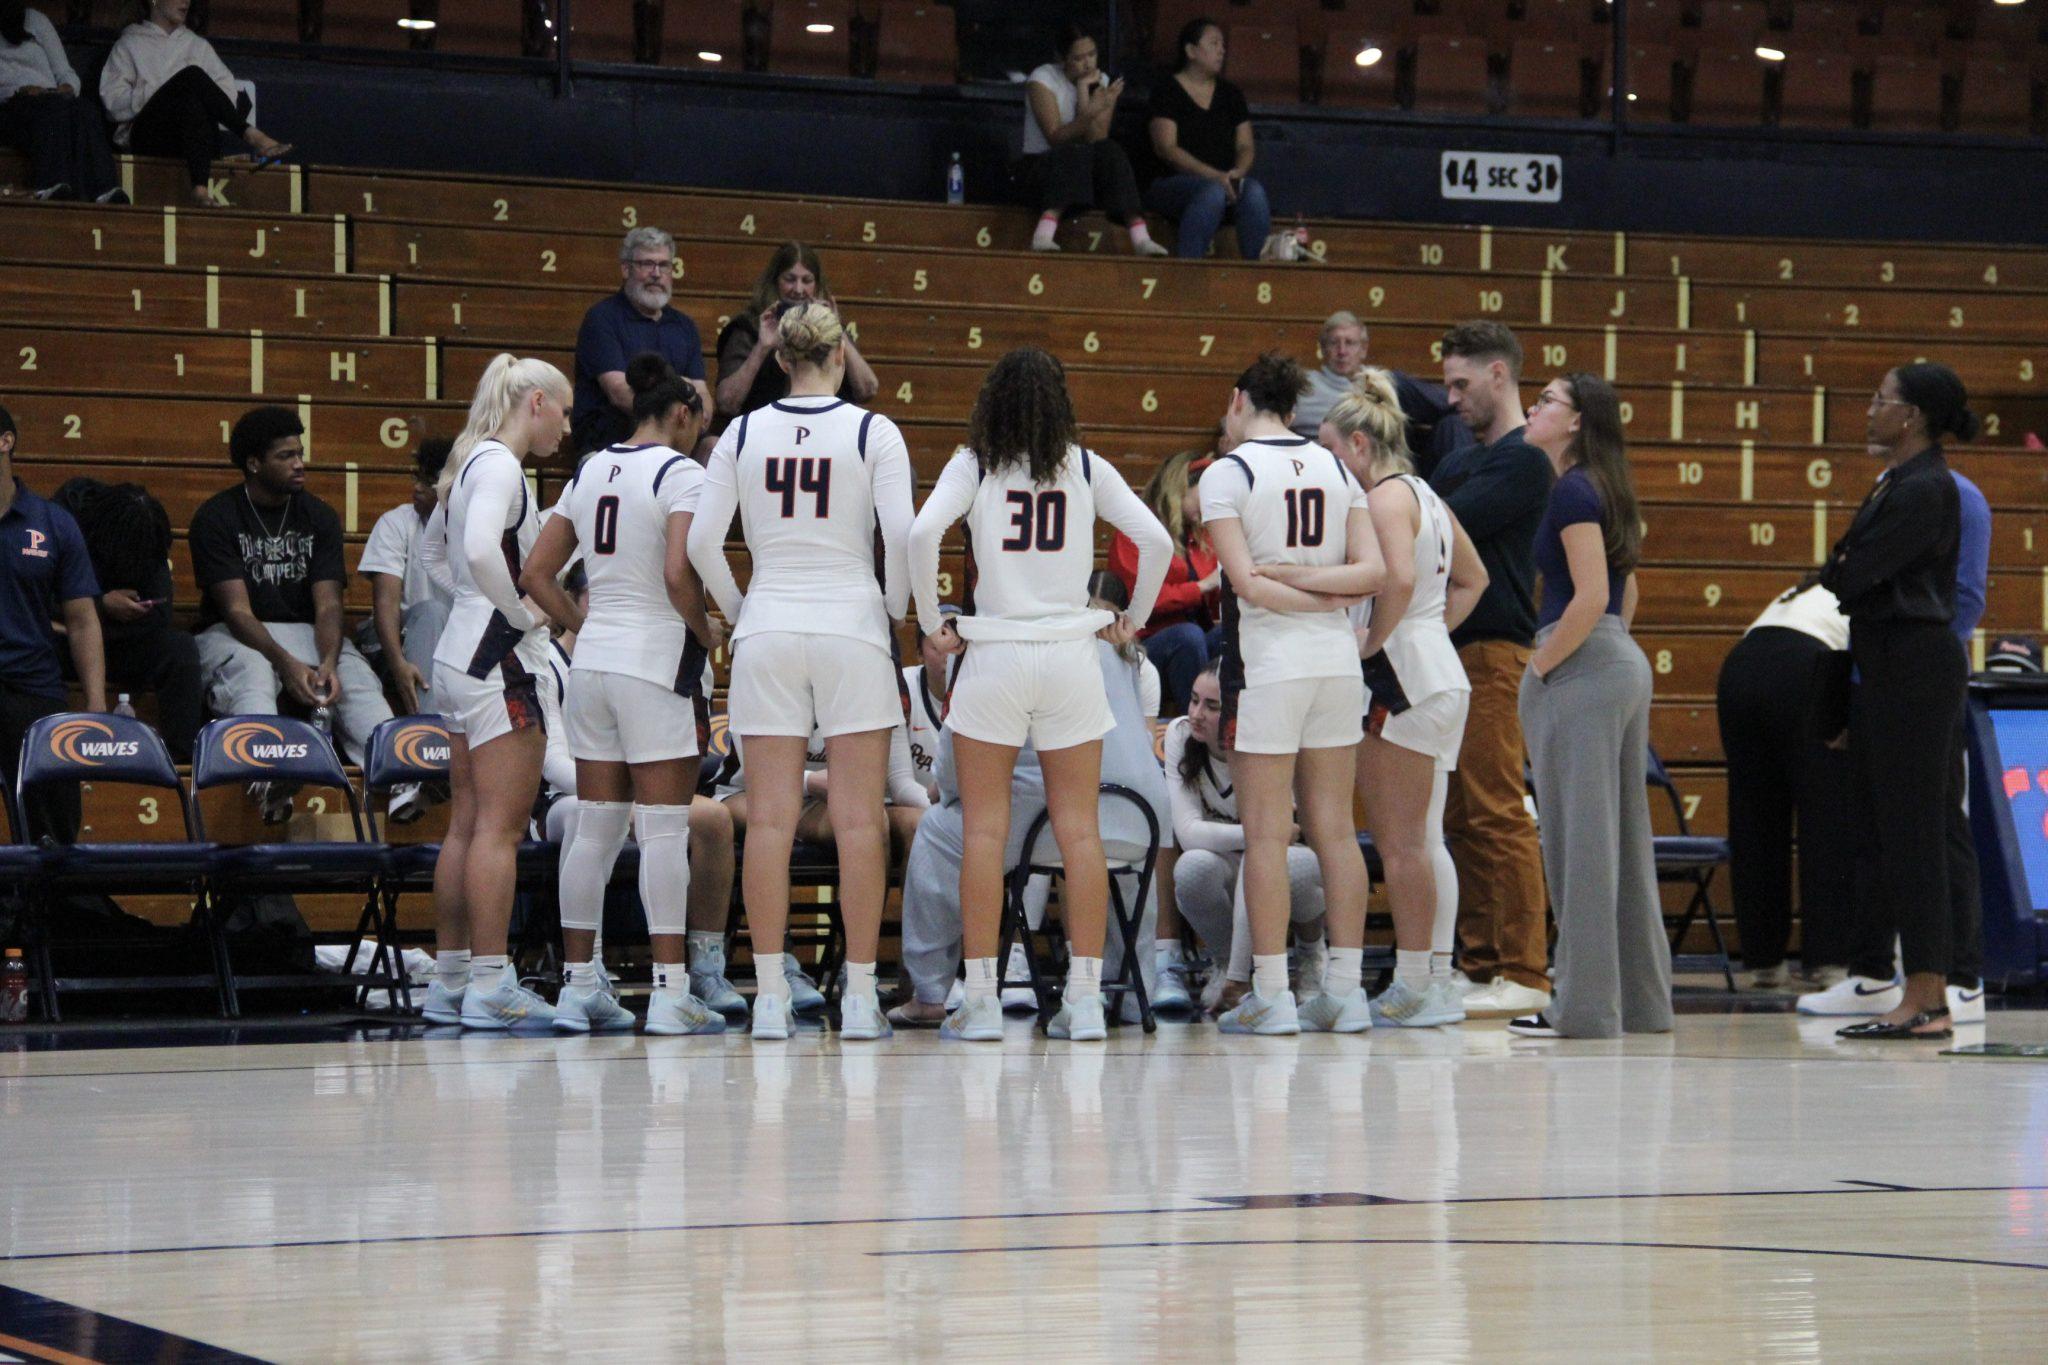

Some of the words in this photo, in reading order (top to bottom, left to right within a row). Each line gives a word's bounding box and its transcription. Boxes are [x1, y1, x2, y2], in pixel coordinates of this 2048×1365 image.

[1462, 158, 1478, 193] 4
[1488, 166, 1518, 188] SEC
[1526, 160, 1542, 194] 3
[364, 193, 372, 212] 1
[494, 199, 508, 220] 2
[622, 207, 637, 228] 3
[740, 215, 755, 234] 4
[92, 229, 101, 250] 1
[863, 222, 876, 242] 5
[976, 227, 991, 247] 6
[1089, 232, 1102, 251] 7
[249, 230, 265, 257] J
[408, 243, 416, 264] 1
[541, 250, 556, 271] 2
[1421, 245, 1443, 265] 10
[1547, 245, 1567, 270] K
[1671, 256, 1679, 275] 1
[1779, 259, 1792, 279] 2
[1881, 262, 1894, 282] 3
[1984, 266, 1997, 284] 4
[914, 270, 927, 291] 5
[1029, 274, 1043, 295] 6
[1142, 279, 1156, 299] 7
[132, 289, 141, 311] 1
[1257, 282, 1271, 304] 8
[1369, 287, 1384, 307] 9
[1479, 291, 1502, 312] 10
[452, 303, 460, 324] 1
[1611, 291, 1625, 317] J
[1737, 302, 1745, 321] 1
[1845, 304, 1858, 325] 2
[1949, 307, 1963, 327] 3
[846, 322, 858, 341] 4
[968, 327, 982, 348] 5
[1084, 332, 1099, 353] 6
[1200, 335, 1214, 356] 7
[20, 347, 36, 370] 2
[175, 354, 184, 376] 1
[1543, 345, 1566, 366] 10
[1804, 355, 1812, 375] 1
[331, 352, 355, 381] H
[2020, 360, 2033, 381] 3
[897, 382, 912, 403] 4
[1142, 390, 1157, 411] 6
[1736, 401, 1758, 428] H
[1986, 414, 2000, 435] 2
[64, 415, 81, 438] 2
[220, 421, 229, 443] 1
[380, 418, 409, 448] G
[793, 425, 811, 446] P
[607, 464, 622, 483] P
[1289, 459, 1304, 477] P
[1679, 462, 1703, 484] 10
[1807, 459, 1832, 488] G
[765, 457, 832, 519] 44
[594, 495, 620, 555] 0
[1002, 490, 1067, 552] 30
[1284, 487, 1326, 548] 10
[26, 529, 45, 549] P
[1750, 523, 1775, 545] 10
[2024, 528, 2032, 550] 1
[938, 573, 953, 596] 3
[1704, 584, 1721, 607] 9
[1656, 650, 1672, 673] 8
[80, 741, 138, 757] WAVES
[251, 744, 308, 760] WAVES
[138, 797, 158, 824] 3
[1684, 795, 1701, 819] 7
